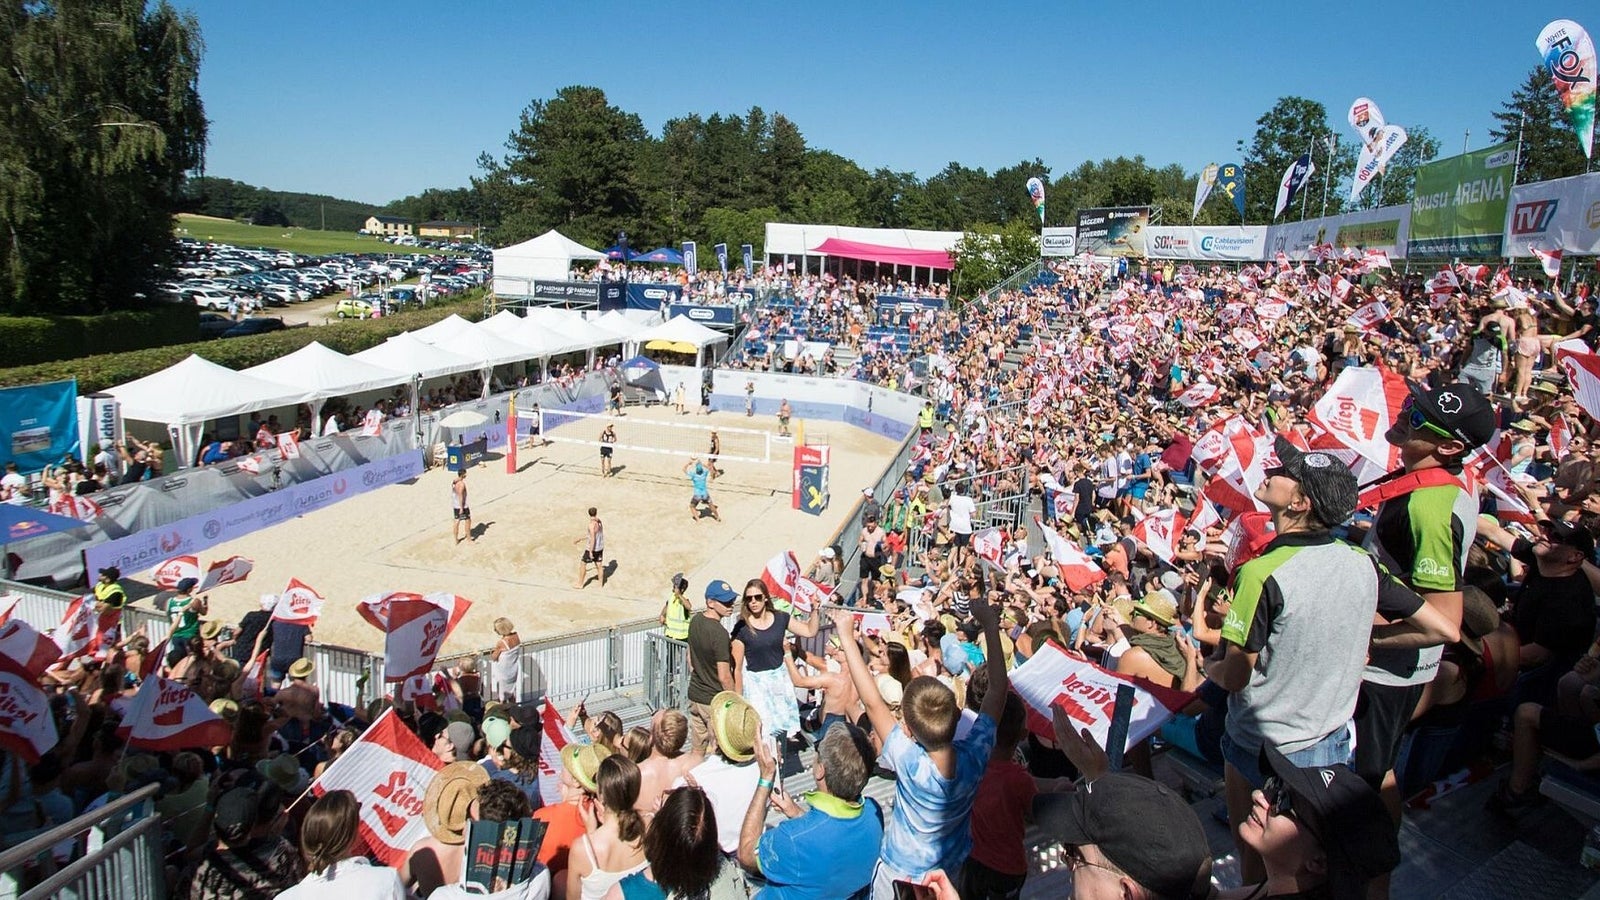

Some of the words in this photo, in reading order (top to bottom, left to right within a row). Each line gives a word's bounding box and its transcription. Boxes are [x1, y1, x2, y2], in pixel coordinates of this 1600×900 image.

[1545, 28, 1567, 44] WHITE
[1550, 36, 1590, 88] FOX
[1413, 191, 1448, 214] spusu
[1452, 175, 1505, 206] ARENA
[372, 771, 424, 817] Stieg
